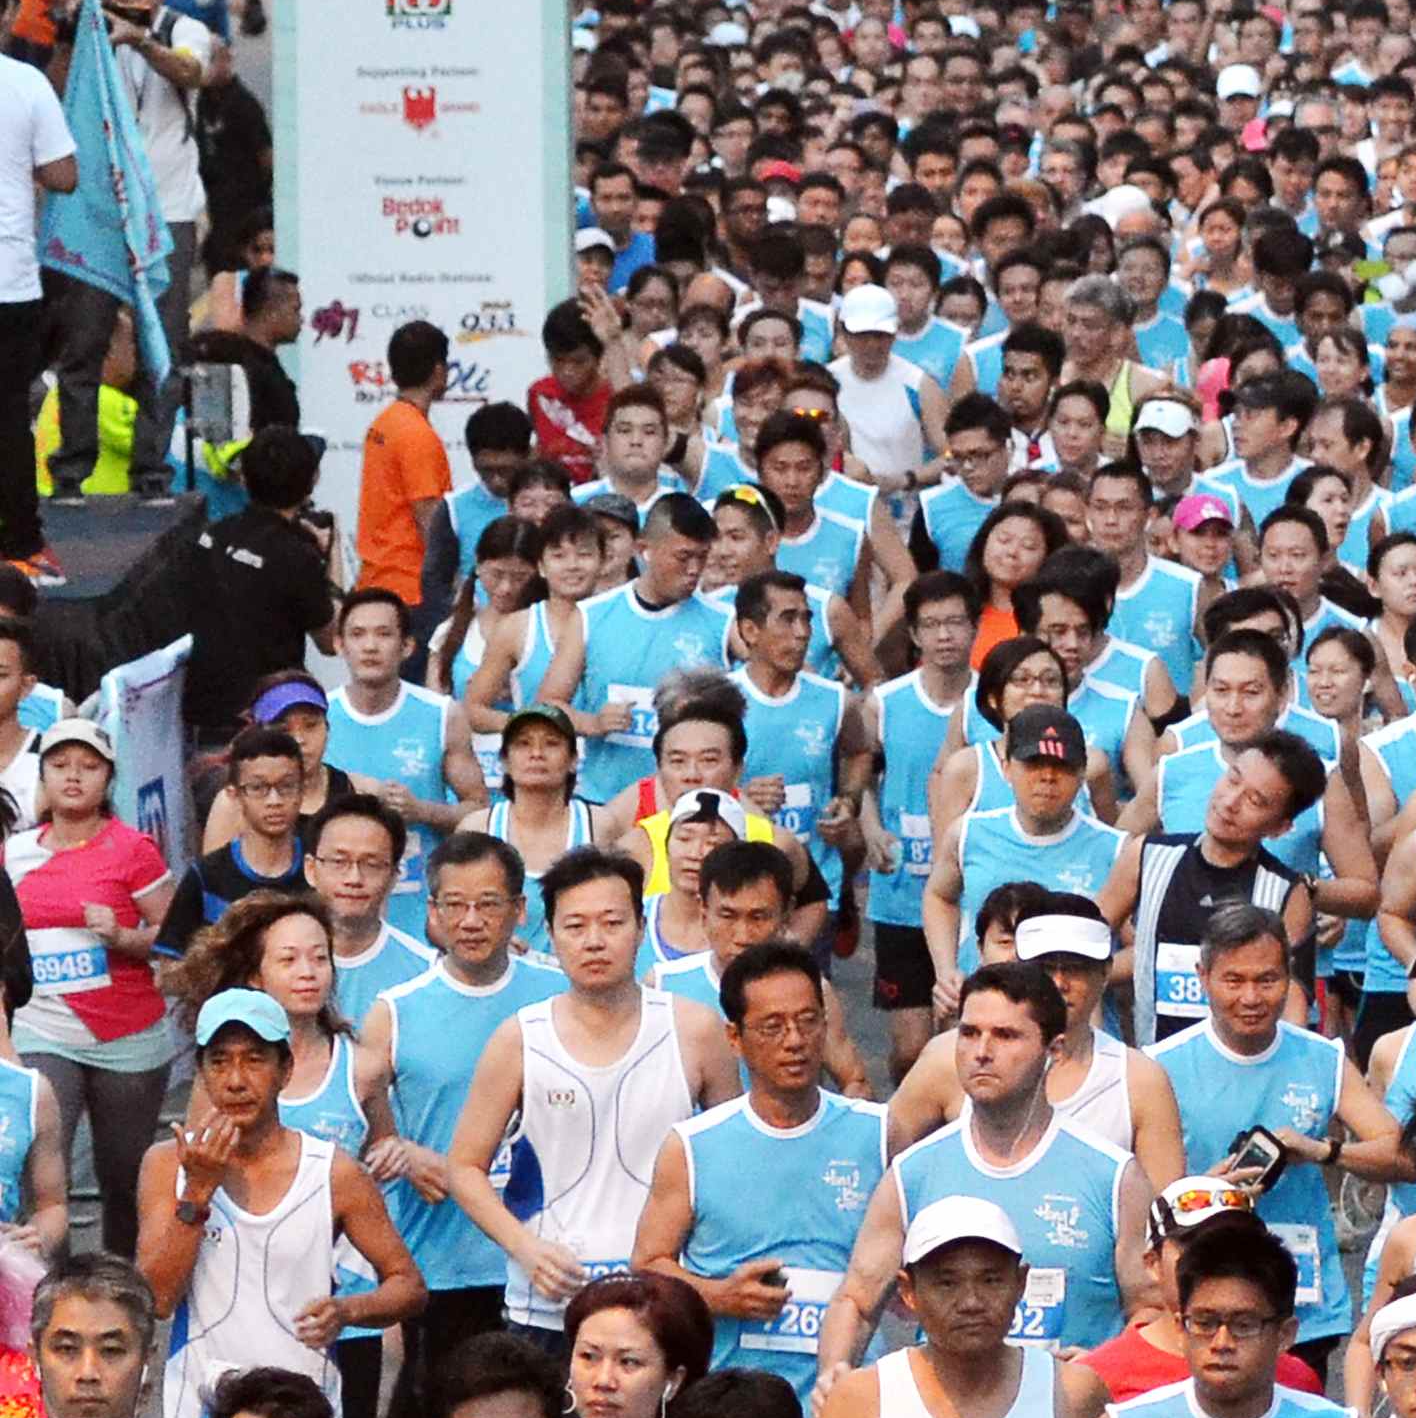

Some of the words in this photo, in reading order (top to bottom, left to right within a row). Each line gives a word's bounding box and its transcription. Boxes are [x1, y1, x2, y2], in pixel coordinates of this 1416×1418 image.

[392, 17, 447, 30] PLUS
[382, 196, 444, 217] Bedok
[395, 216, 461, 239] Point
[33, 951, 93, 984] 6948
[1167, 975, 1202, 1003] 38
[764, 1303, 826, 1338] 26
